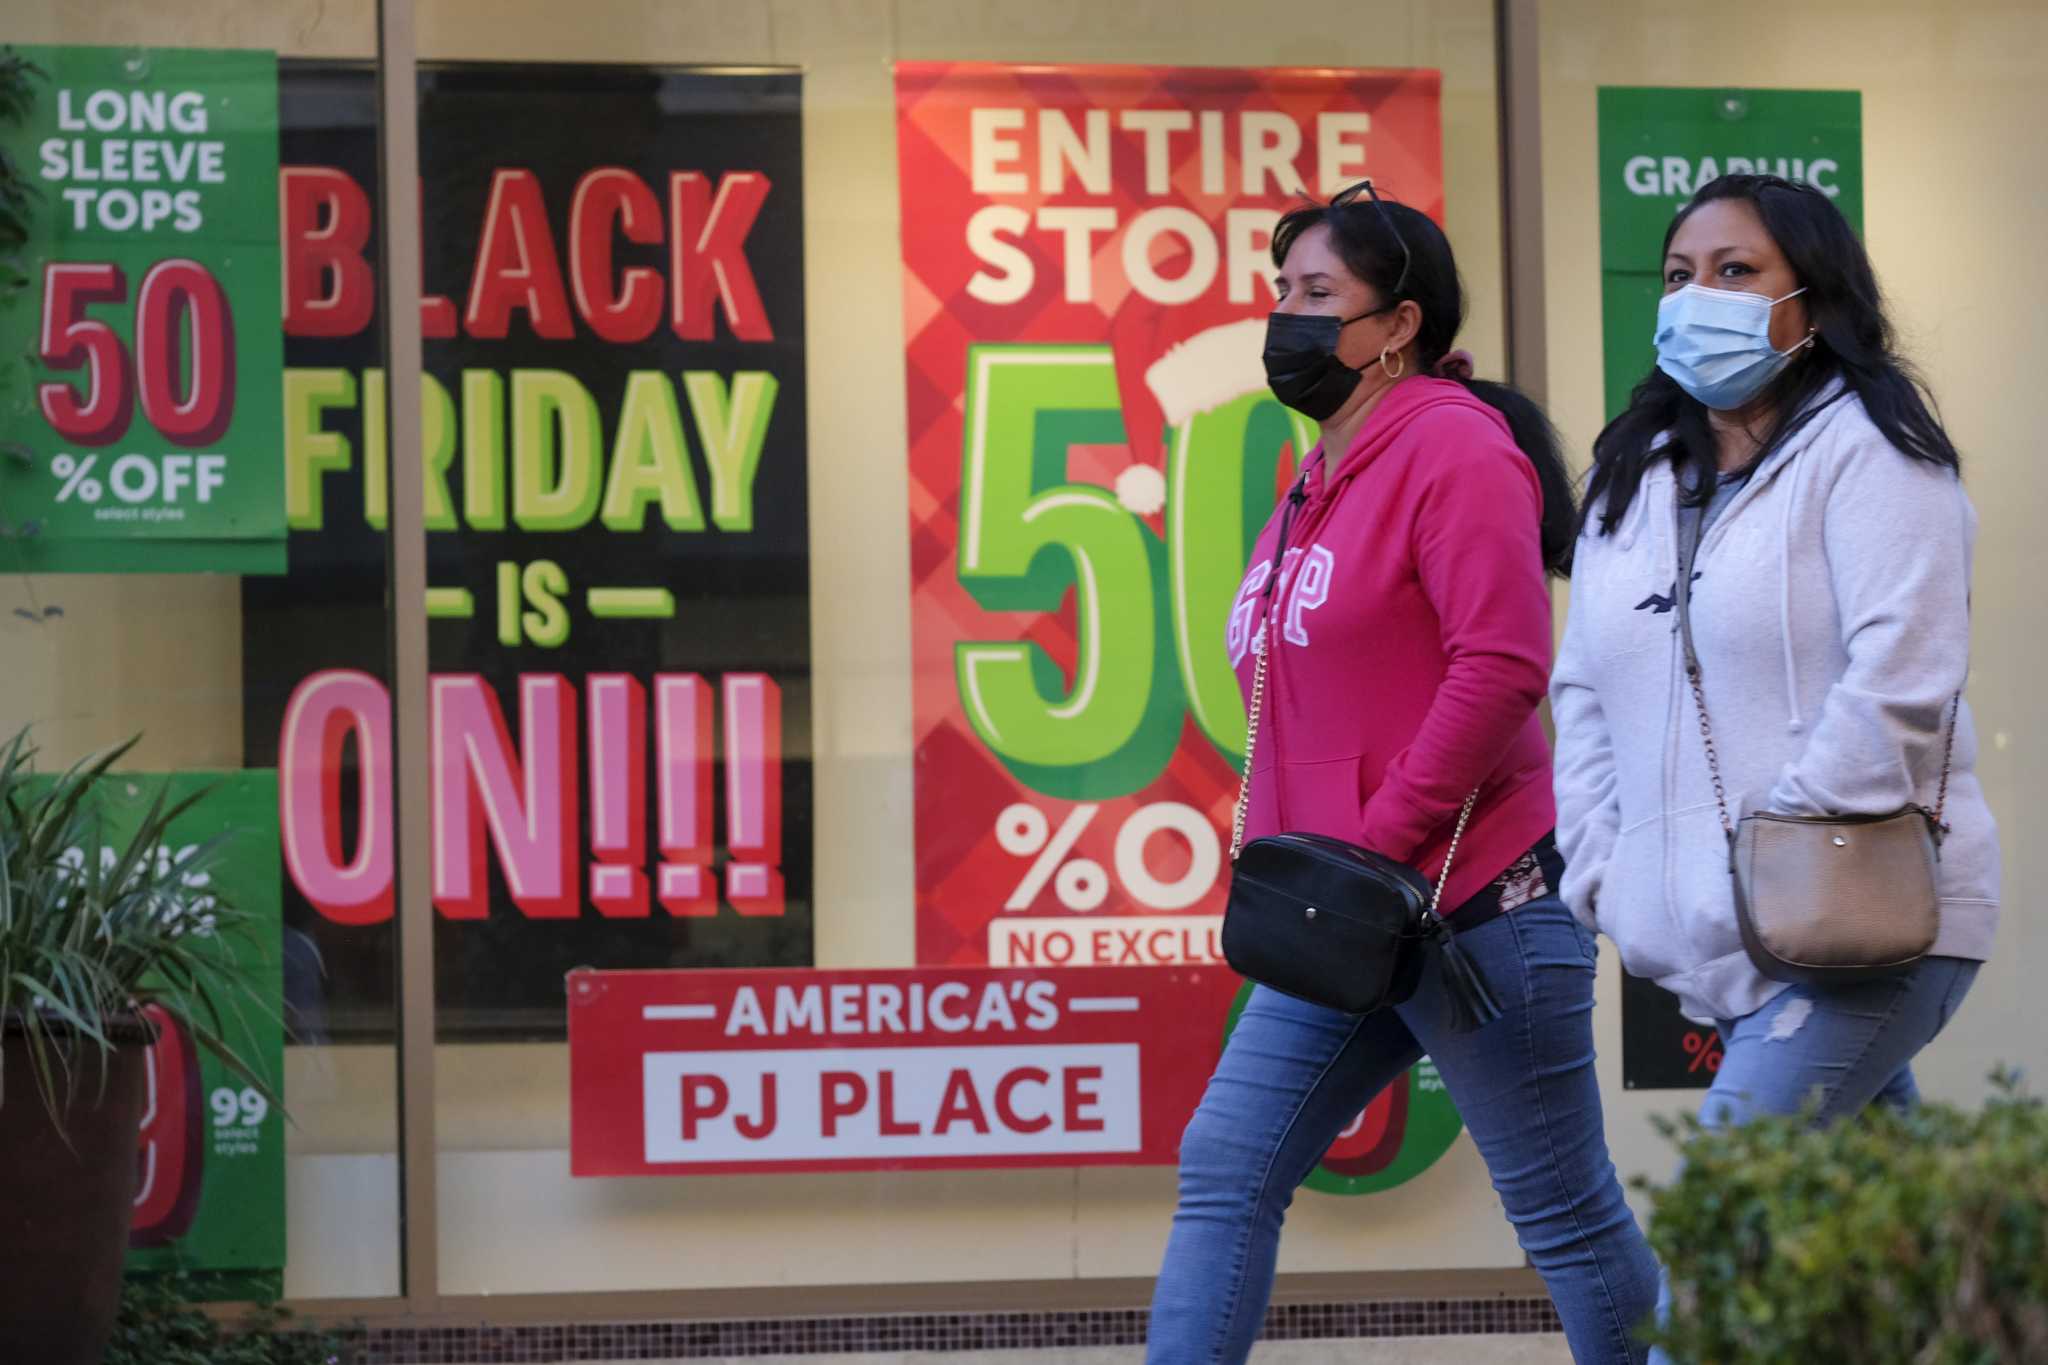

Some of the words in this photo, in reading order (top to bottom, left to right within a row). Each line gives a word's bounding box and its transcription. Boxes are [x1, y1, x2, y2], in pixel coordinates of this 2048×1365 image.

[57, 89, 209, 133] LONG
[969, 108, 1373, 195] ENTIRE
[39, 139, 226, 183] SLEEVE
[62, 188, 203, 232] TOPS
[279, 164, 775, 342] BACK
[965, 205, 1276, 305] STOR
[38, 258, 236, 448] 50
[50, 453, 227, 503] %OFF
[283, 367, 779, 531] FRIDAY
[497, 559, 571, 648] IS
[954, 343, 1322, 801] 50
[278, 668, 786, 926] ON!!!
[1008, 931, 1075, 964] NO
[1091, 929, 1228, 963] EXCLU
[724, 981, 1059, 1035] AMERICA'S
[210, 1086, 268, 1127] 99
[680, 1072, 777, 1141] PJ
[819, 1066, 1105, 1137] PLACE
